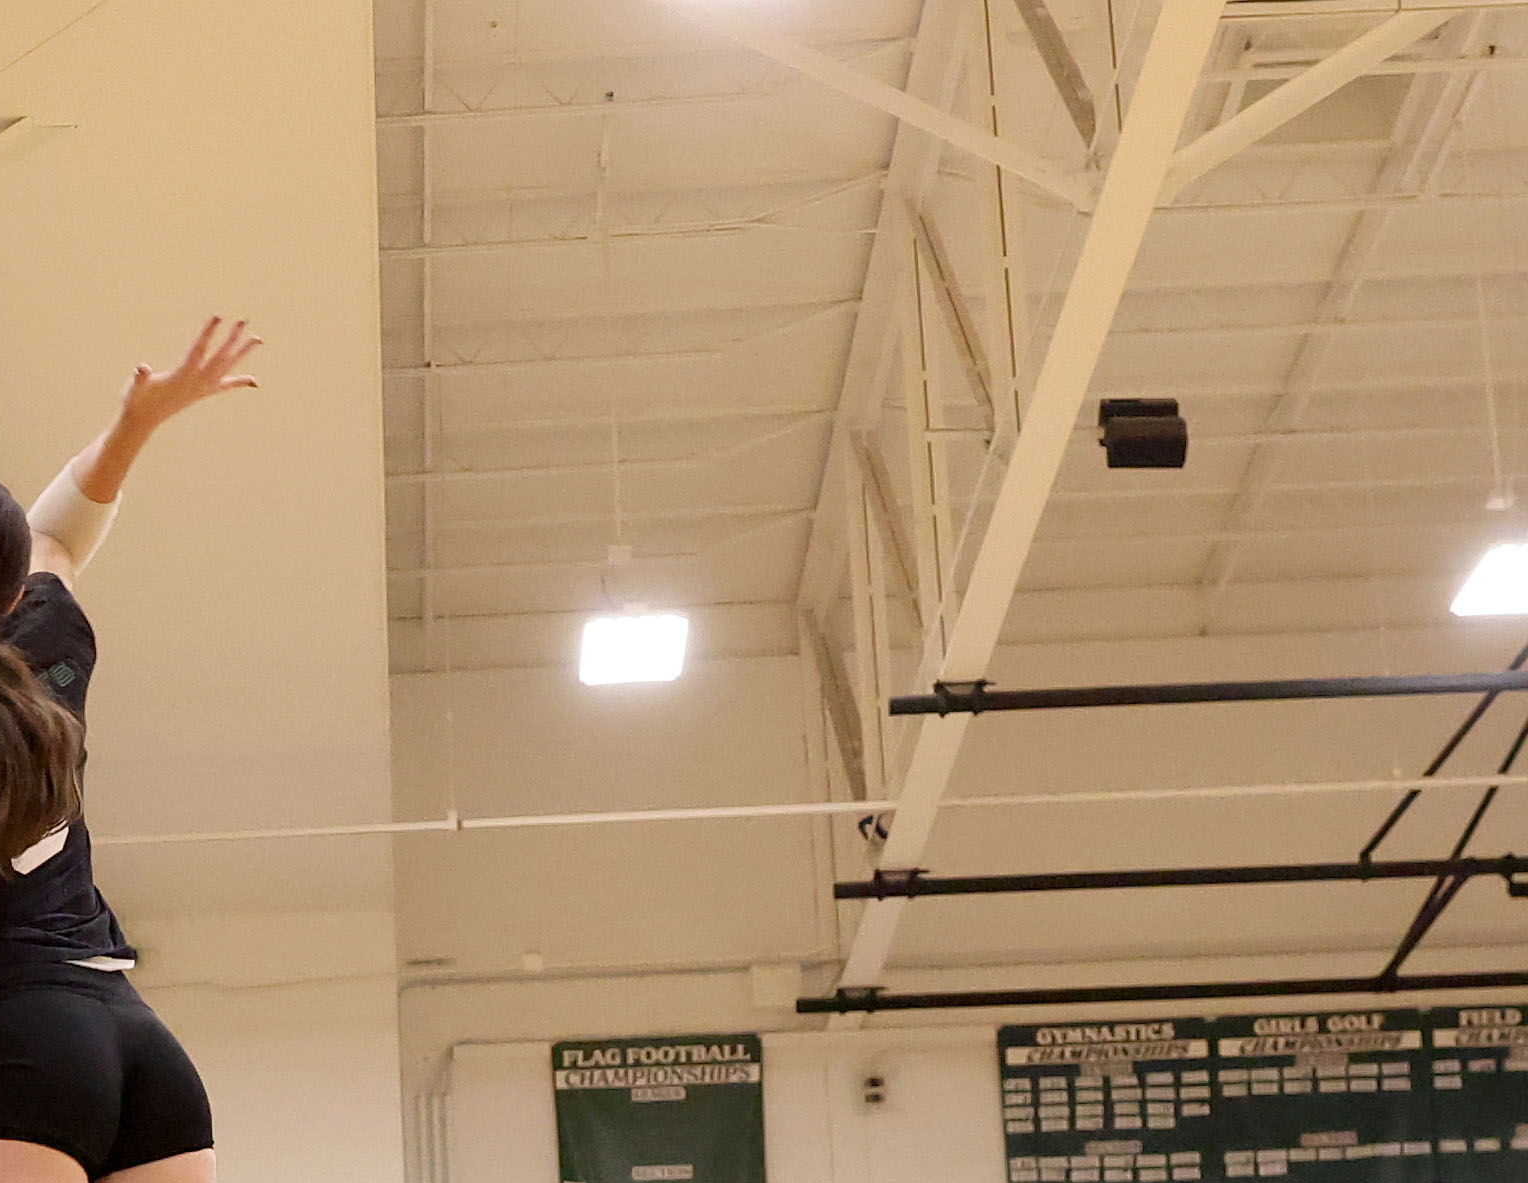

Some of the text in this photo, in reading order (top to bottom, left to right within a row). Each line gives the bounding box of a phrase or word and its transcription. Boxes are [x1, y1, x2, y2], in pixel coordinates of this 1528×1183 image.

[1036, 1023, 1175, 1044] GYMNASTICS
[1326, 1013, 1386, 1032] GOLF
[562, 1044, 751, 1067] FLAG FOOTBALL
[564, 1064, 751, 1088] CHAMPIONSHIPS
